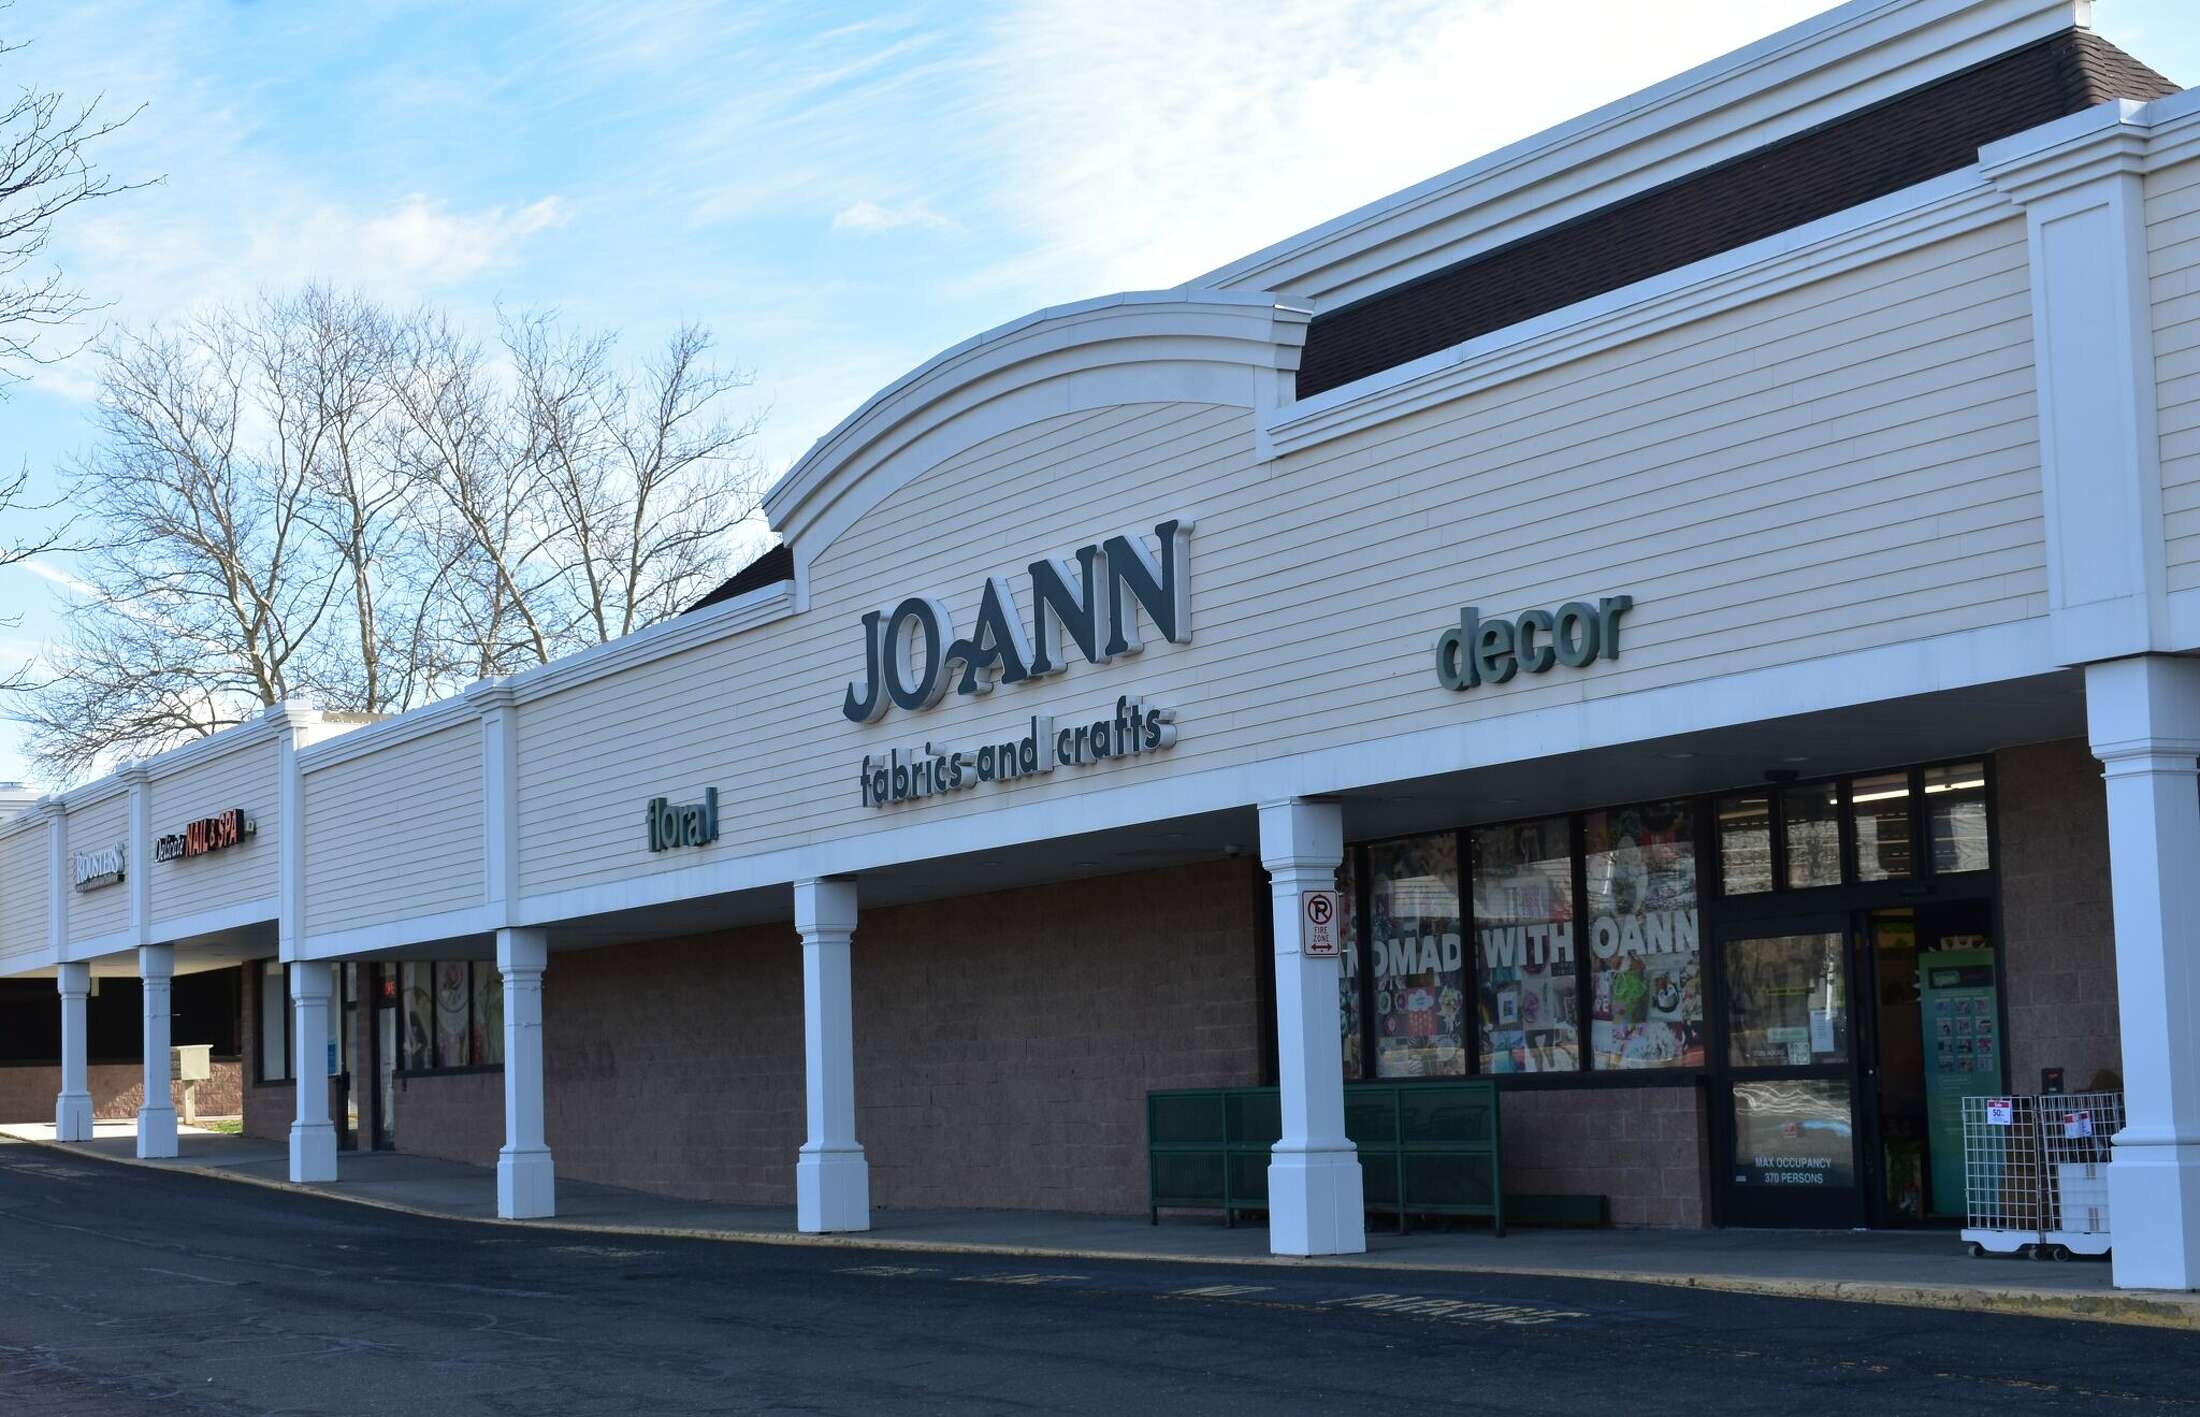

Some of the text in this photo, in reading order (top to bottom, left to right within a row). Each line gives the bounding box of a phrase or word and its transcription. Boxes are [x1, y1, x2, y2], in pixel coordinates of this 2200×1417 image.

[843, 519, 1194, 723] JOANN
[1435, 595, 1633, 691] decor
[861, 696, 1176, 808] fabrics and crafts
[186, 818, 209, 857] NAIL
[218, 808, 241, 848] SPA
[1482, 921, 1575, 968] WITH
[1590, 909, 1700, 959] OANN
[1755, 1157, 1832, 1169] MAX OCCUPANCY
[1781, 1173, 1824, 1184] PERSONS
